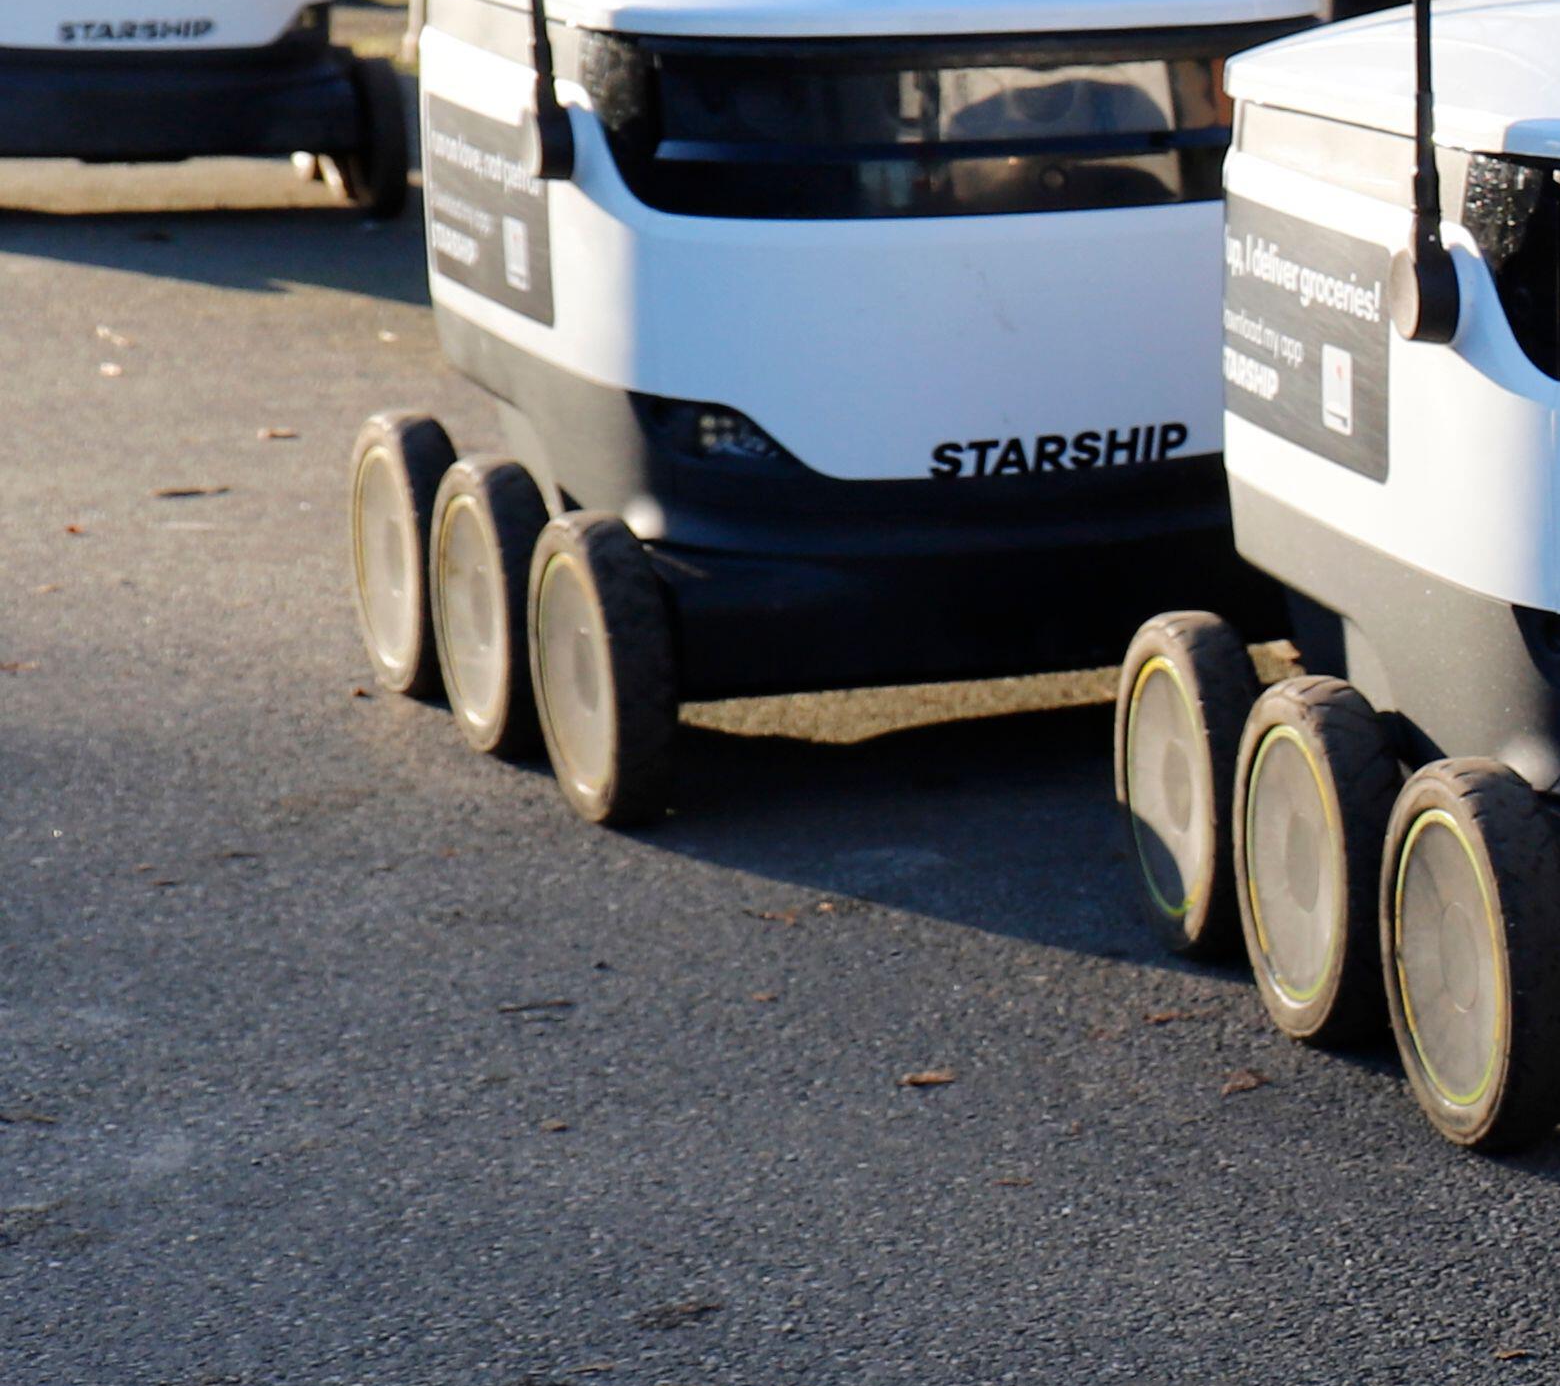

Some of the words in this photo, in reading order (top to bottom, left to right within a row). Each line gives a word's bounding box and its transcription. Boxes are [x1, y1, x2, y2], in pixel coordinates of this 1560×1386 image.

[58, 19, 216, 43] STARSHIP
[1253, 237, 1300, 293] deliver
[1299, 267, 1382, 323] groceries!
[929, 422, 1188, 480] STARSHIP
